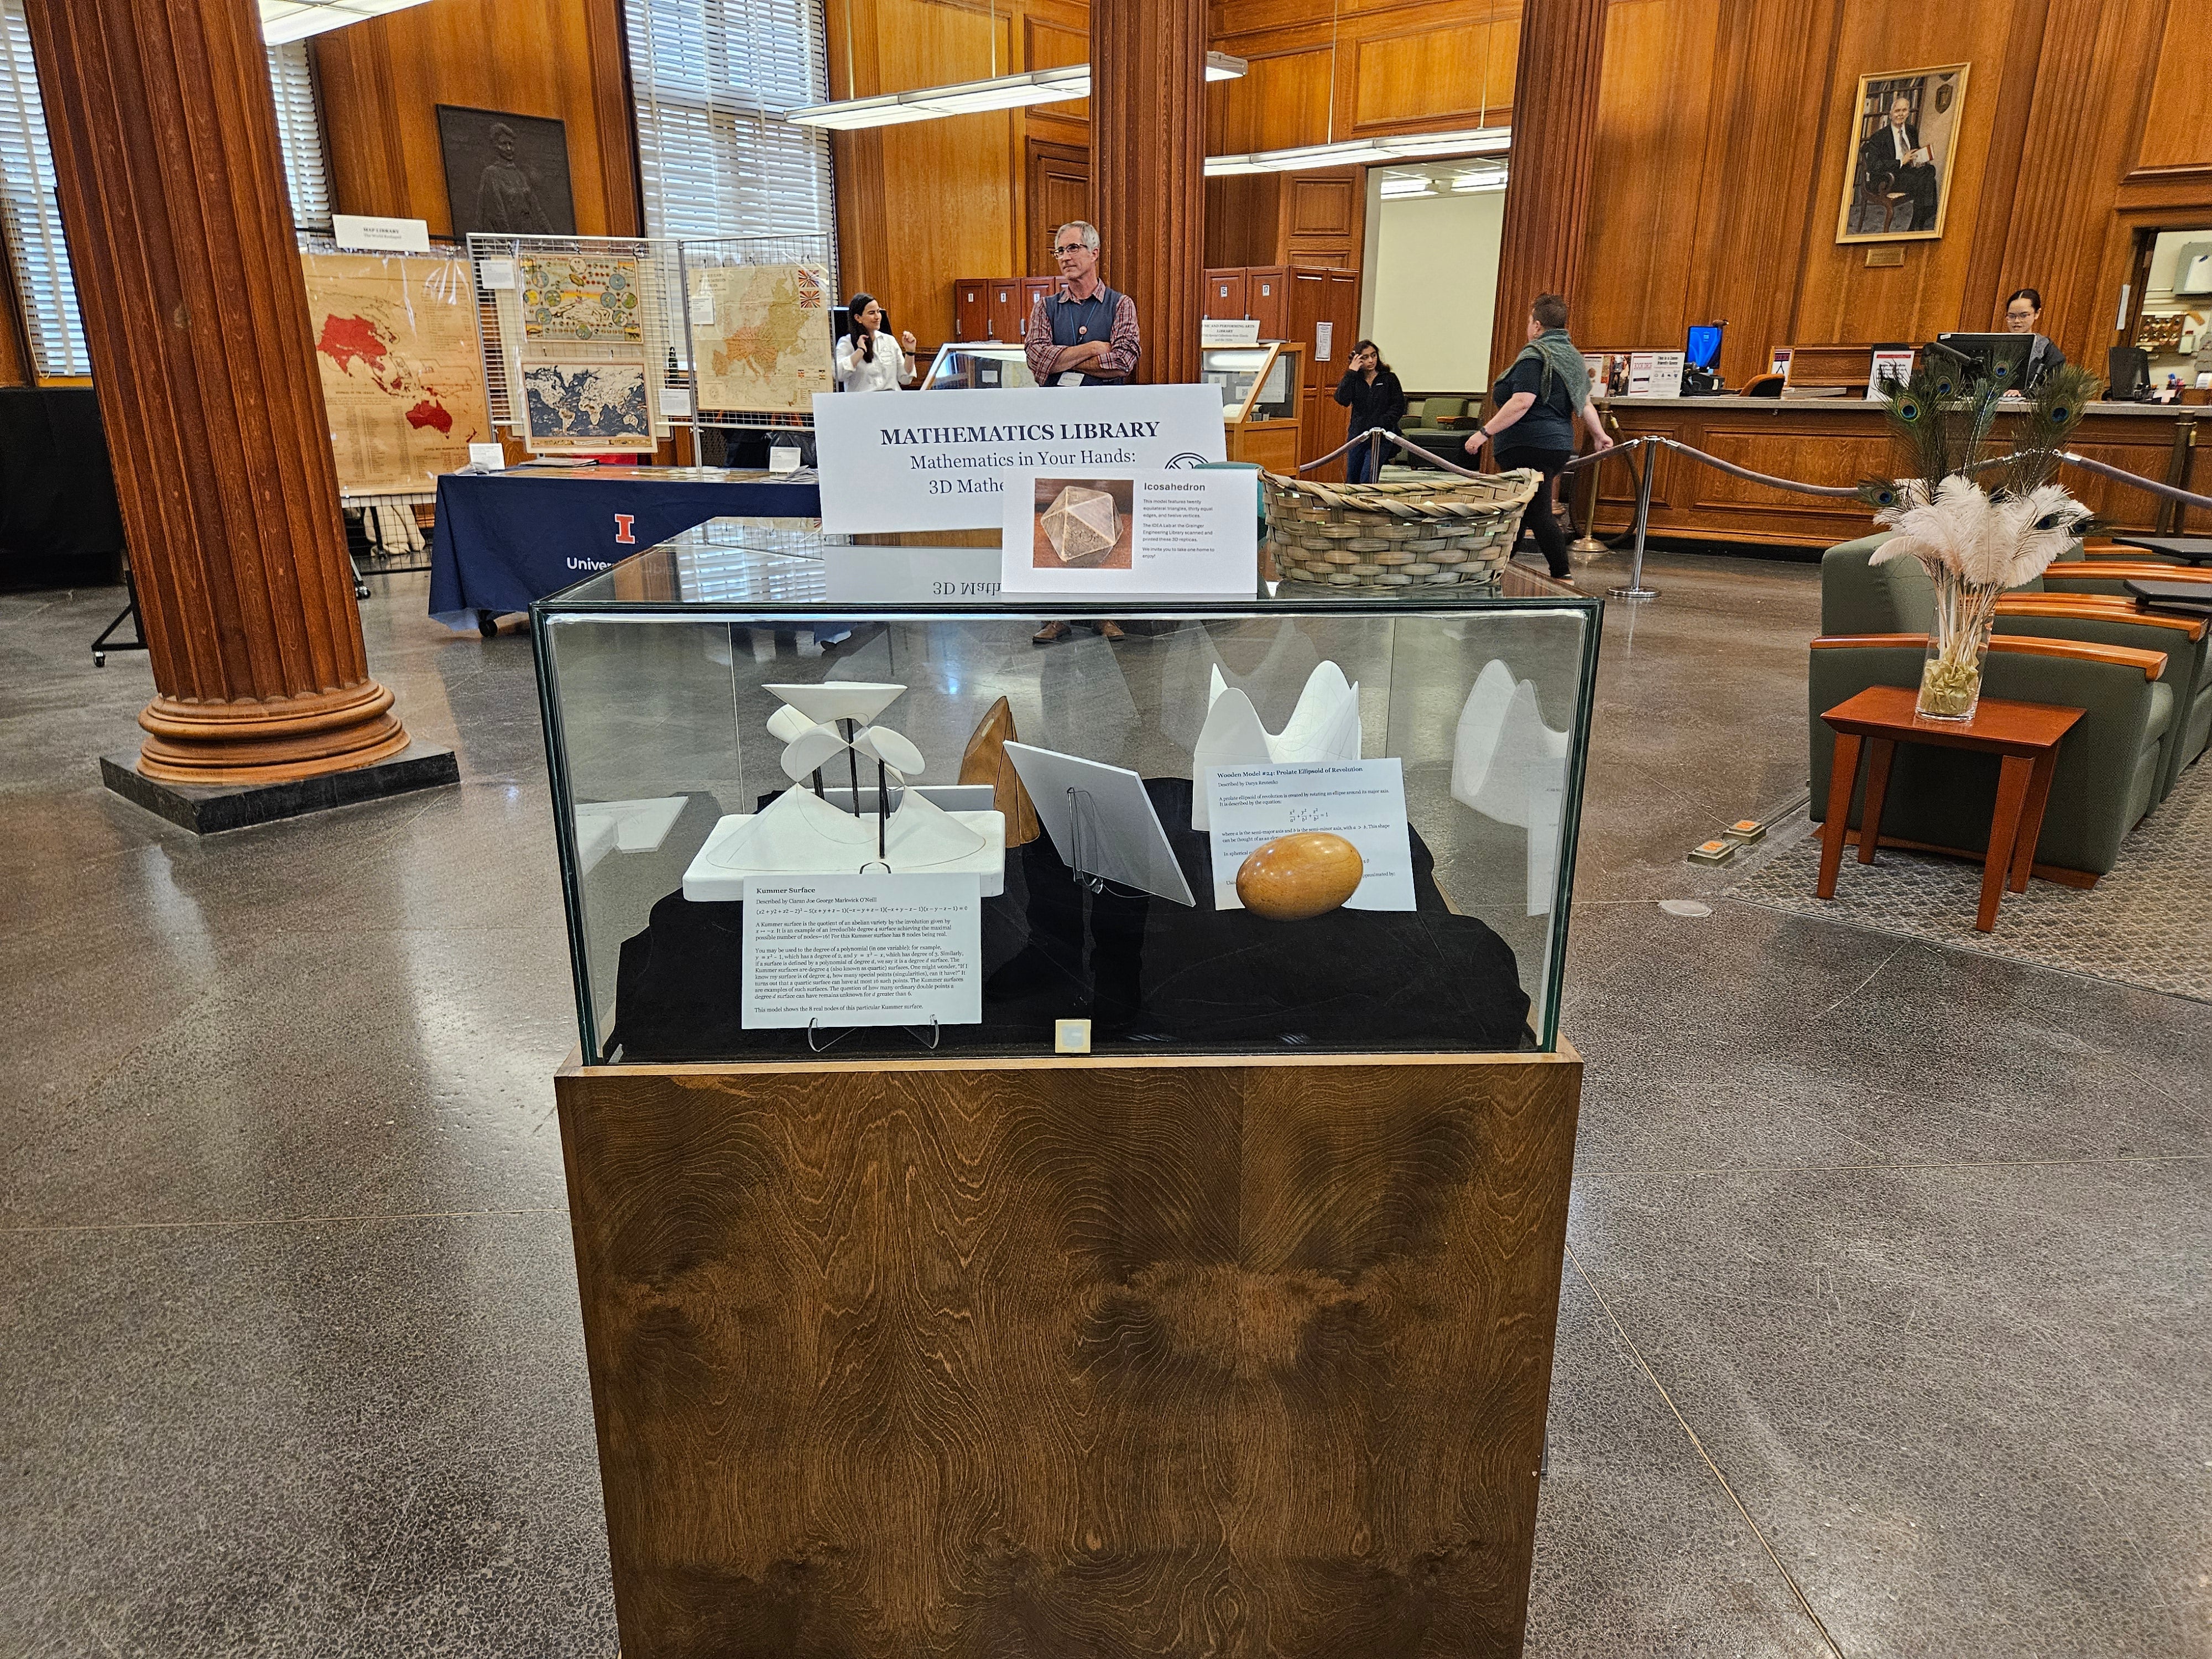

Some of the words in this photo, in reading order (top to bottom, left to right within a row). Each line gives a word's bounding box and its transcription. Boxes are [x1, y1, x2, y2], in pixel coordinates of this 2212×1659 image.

[880, 425, 1054, 445] MATHEMATICS
[1060, 421, 1160, 439] LIBRARY
[910, 452, 1014, 469] Mathematics
[1019, 452, 1034, 466] in
[1037, 451, 1076, 465] Your
[1081, 448, 1135, 464] Hands:
[929, 480, 952, 494] 3D
[1144, 483, 1205, 491] Icosahedron
[615, 513, 635, 544] I
